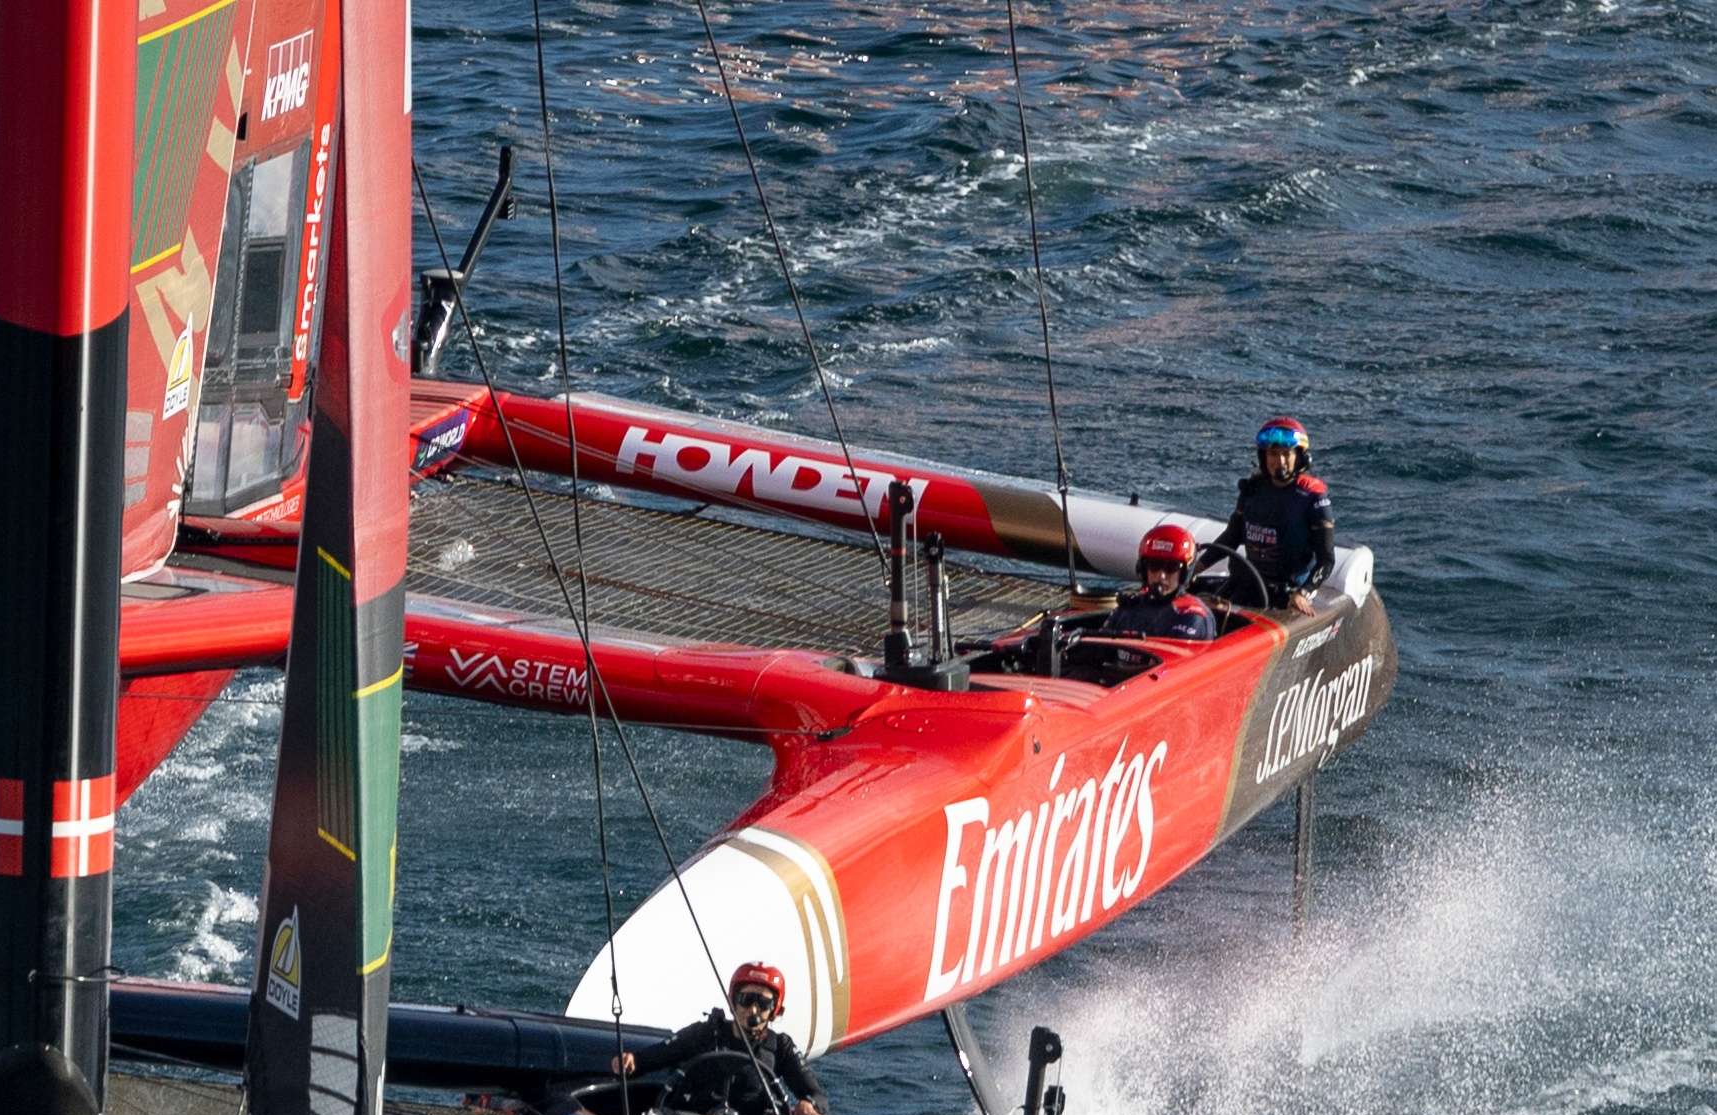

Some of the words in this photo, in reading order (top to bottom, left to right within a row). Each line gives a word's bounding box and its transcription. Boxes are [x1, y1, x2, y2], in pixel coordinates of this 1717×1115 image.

[261, 62, 309, 121] KPMG
[295, 123, 330, 361] smarkets
[616, 426, 929, 524] HOWDEN
[509, 679, 587, 706] CREW
[512, 659, 588, 690] STEM
[924, 735, 1167, 1002] Emirates
[268, 978, 299, 1011] DOYLE
